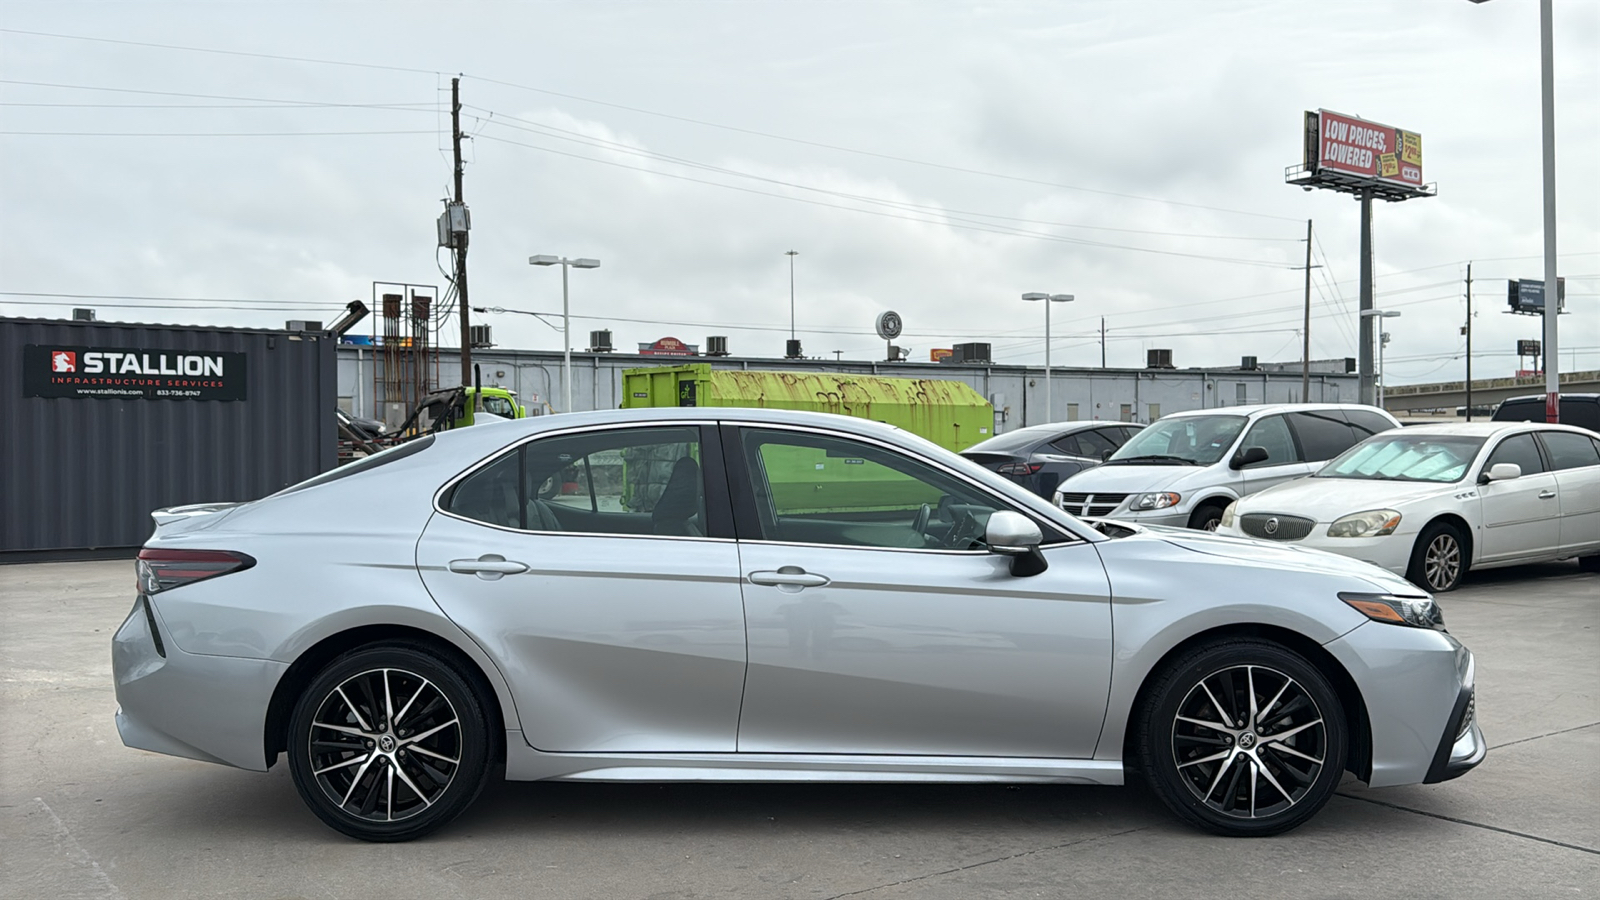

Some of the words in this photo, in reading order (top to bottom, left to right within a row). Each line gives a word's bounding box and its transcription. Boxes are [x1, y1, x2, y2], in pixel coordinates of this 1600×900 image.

[1324, 119, 1348, 142] LOW
[1348, 125, 1386, 153] PRICES,
[1324, 141, 1373, 169] LOWERED
[83, 352, 224, 377] STALLION
[51, 377, 162, 387] INFRASTRUCTURE
[166, 379, 224, 388] SERVICES
[76, 388, 144, 396] www.stallionis.com
[156, 389, 202, 397] 833-736-8747
